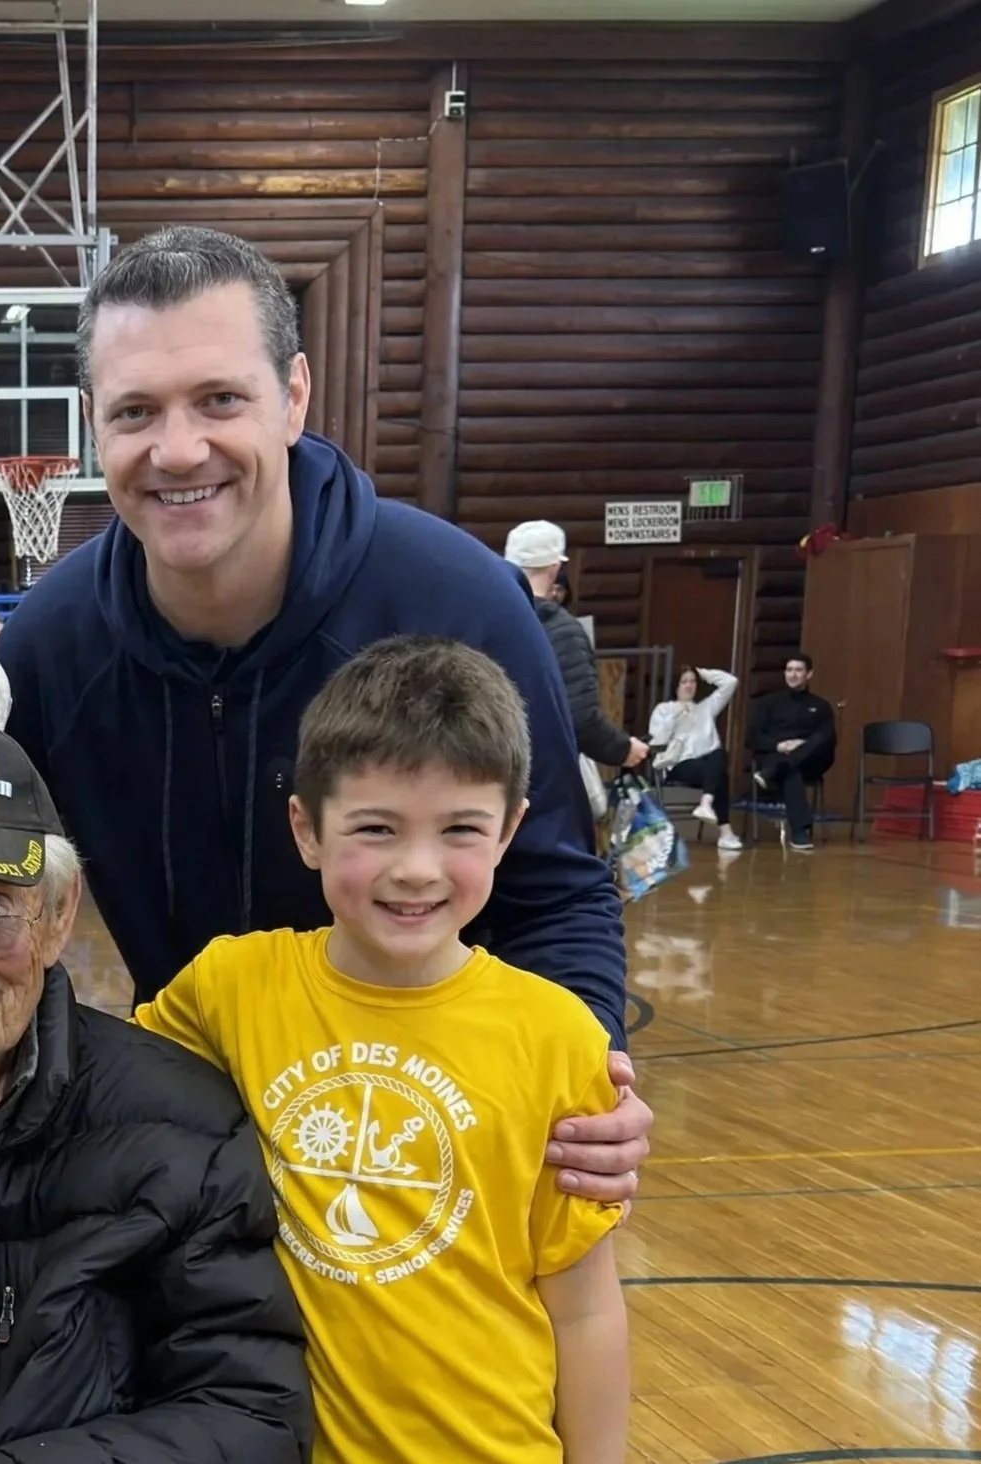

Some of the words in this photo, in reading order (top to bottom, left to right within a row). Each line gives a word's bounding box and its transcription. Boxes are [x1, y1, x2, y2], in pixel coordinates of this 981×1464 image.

[608, 506, 629, 516] MENS
[632, 505, 677, 515] RESTROOM
[608, 518, 629, 528] MENS
[263, 1060, 306, 1109] CITY
[311, 1044, 342, 1073] OF
[351, 1042, 399, 1067] DES
[401, 1054, 477, 1131] MOINES
[279, 1222, 358, 1285] RECREATION
[375, 1251, 433, 1285] SENIOR
[427, 1188, 475, 1256] SERVICES
